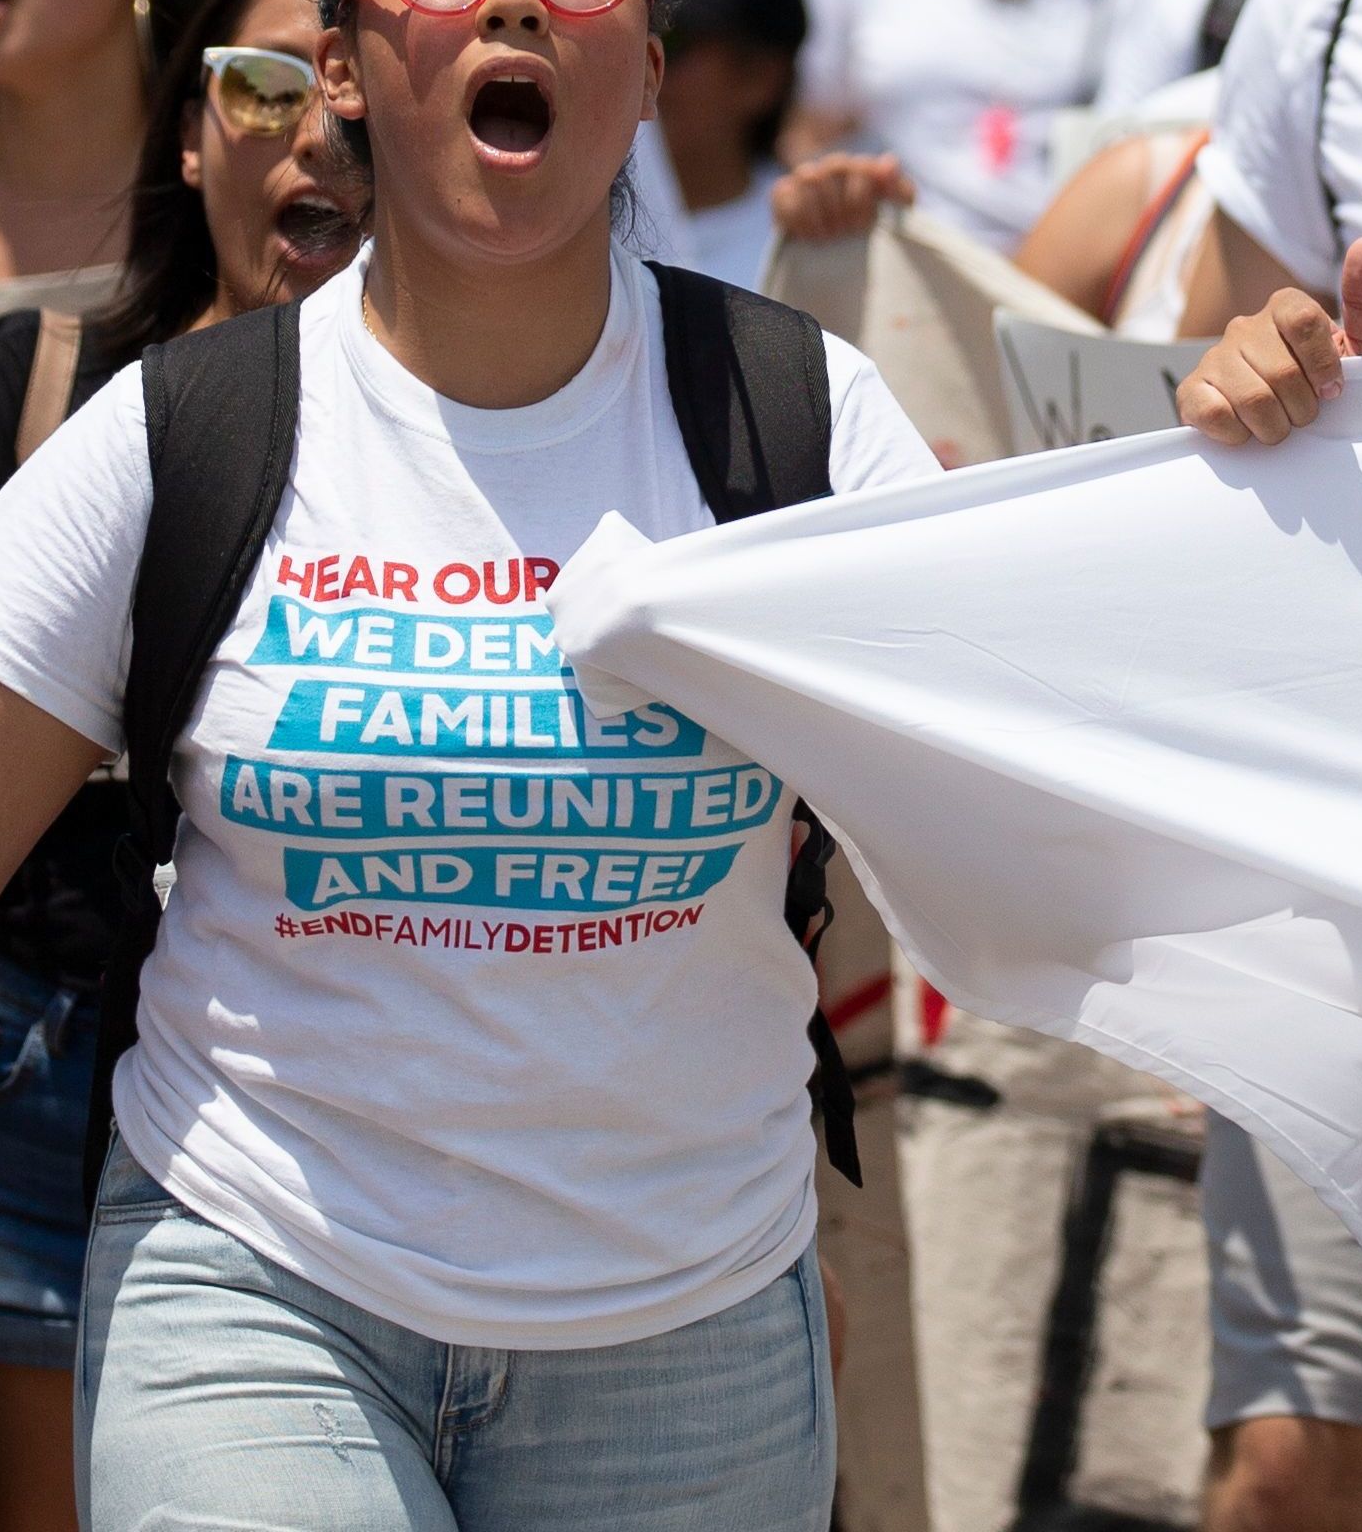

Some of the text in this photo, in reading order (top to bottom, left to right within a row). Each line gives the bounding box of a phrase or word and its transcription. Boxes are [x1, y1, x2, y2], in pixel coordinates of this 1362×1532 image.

[277, 554, 562, 605] HEAR OUR
[285, 604, 393, 666] WE
[319, 686, 680, 748] FAMILIES
[231, 762, 772, 830] ARE REUNITED
[312, 854, 704, 906] AND FREE!
[274, 902, 706, 954] #ENDFAMILYDETENTION
